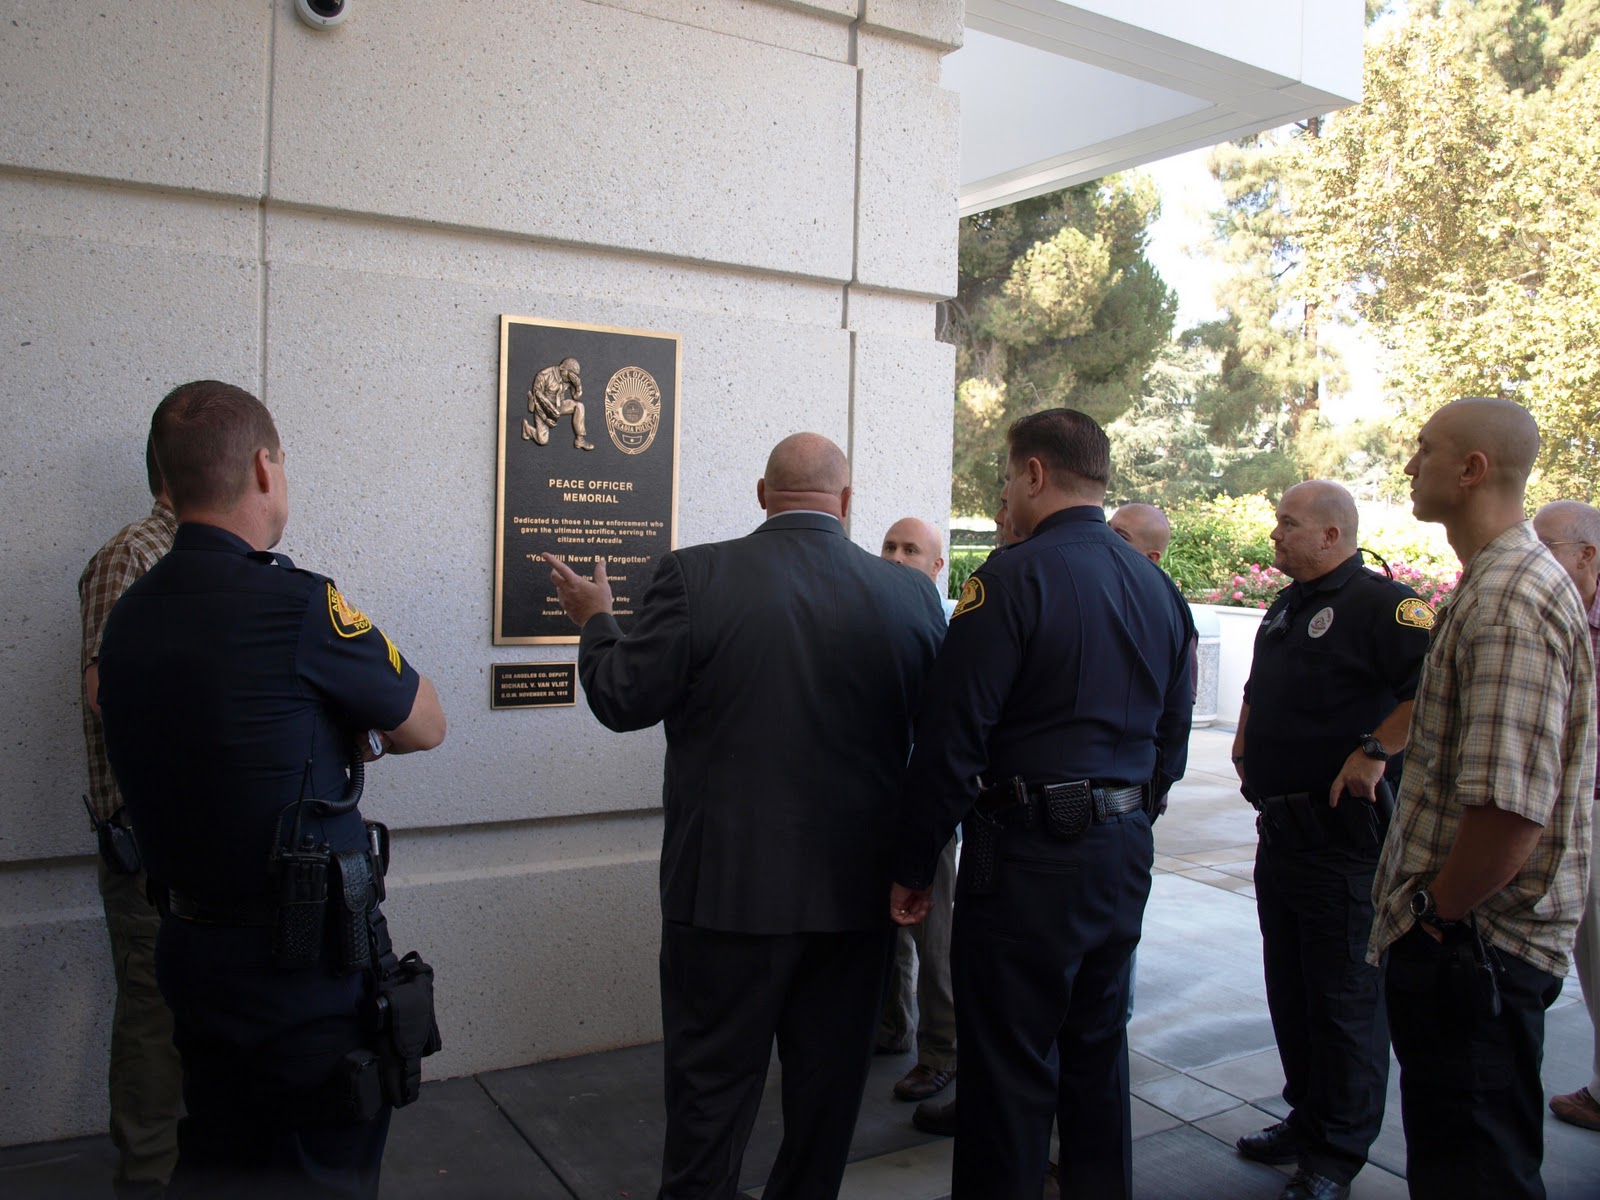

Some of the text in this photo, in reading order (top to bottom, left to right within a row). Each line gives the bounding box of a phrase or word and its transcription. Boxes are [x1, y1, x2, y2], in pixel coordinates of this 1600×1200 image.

[549, 479, 633, 491] PEACE OFFICER
[564, 493, 619, 504] MEMORIAL
